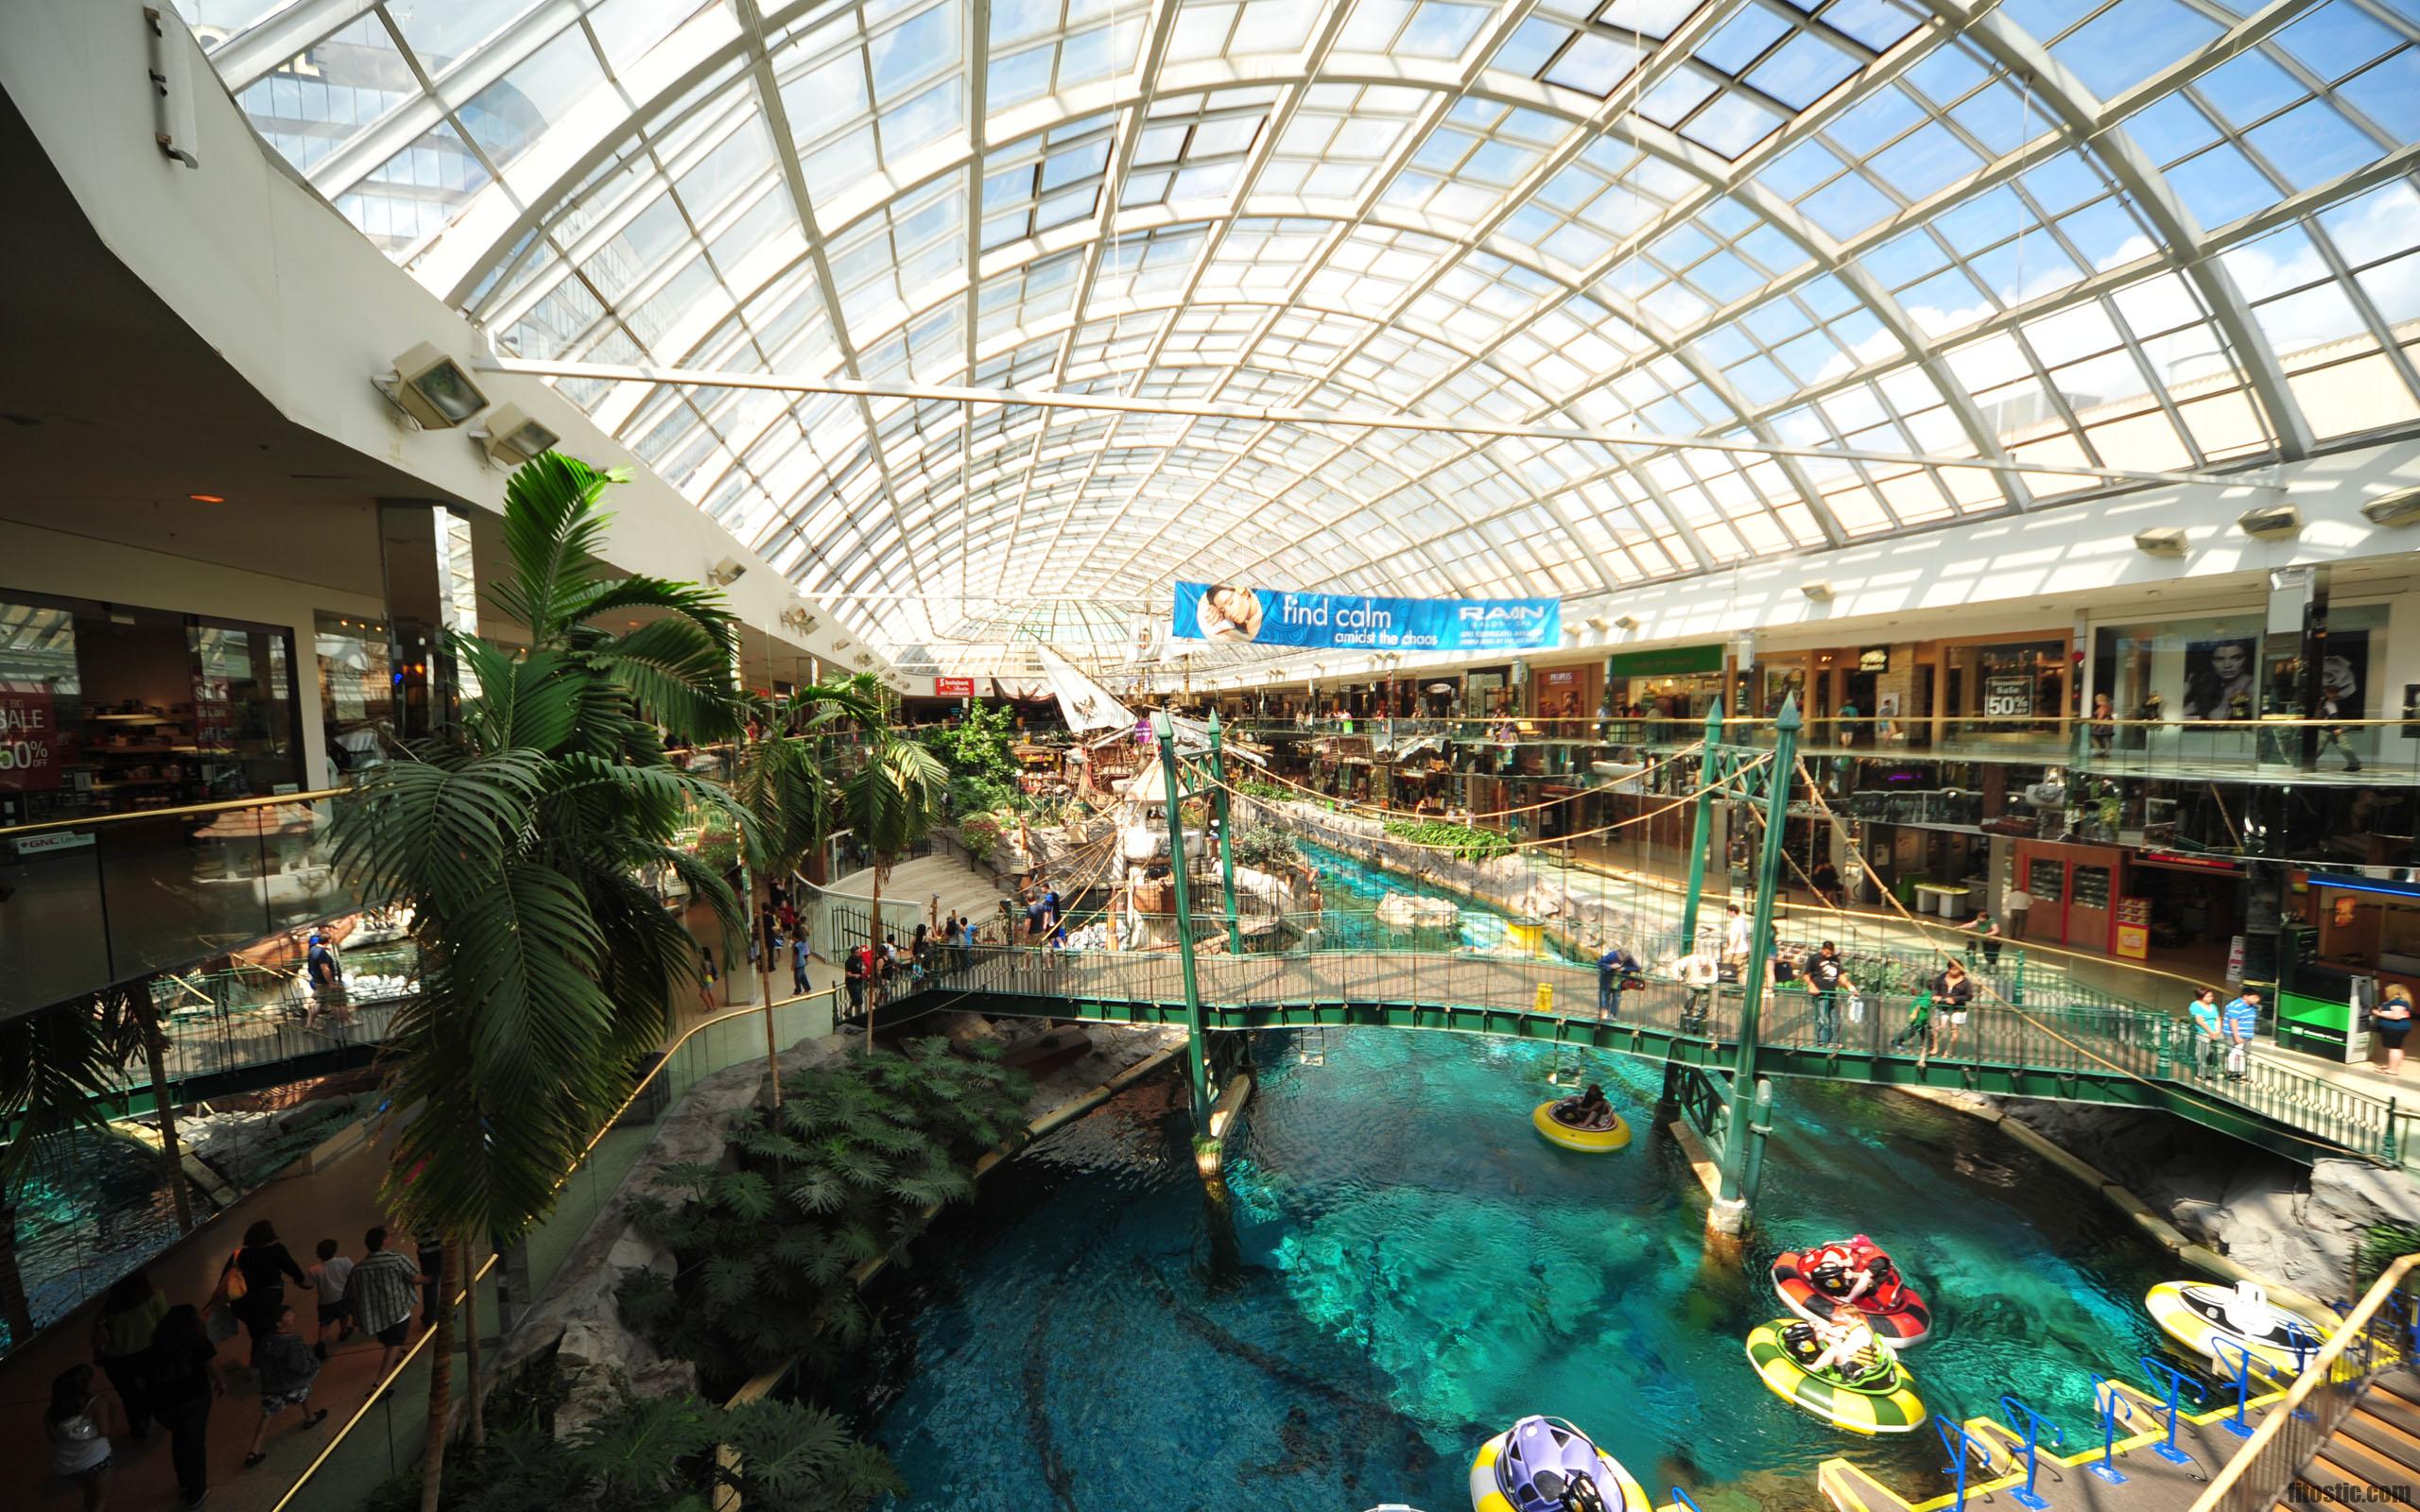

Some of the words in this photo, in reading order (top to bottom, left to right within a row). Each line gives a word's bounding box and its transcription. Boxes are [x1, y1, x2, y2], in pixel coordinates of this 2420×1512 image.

[1284, 594, 1328, 626] find
[1336, 600, 1392, 628] calm
[1460, 606, 1544, 620] RAIN
[1335, 629, 1376, 644] amidst
[1379, 630, 1398, 644] the
[1402, 630, 1438, 645] chaos
[1988, 696, 2028, 715] 50%
[0, 709, 44, 730] SALE
[32, 758, 48, 767] OFF
[29, 837, 60, 848] GNC
